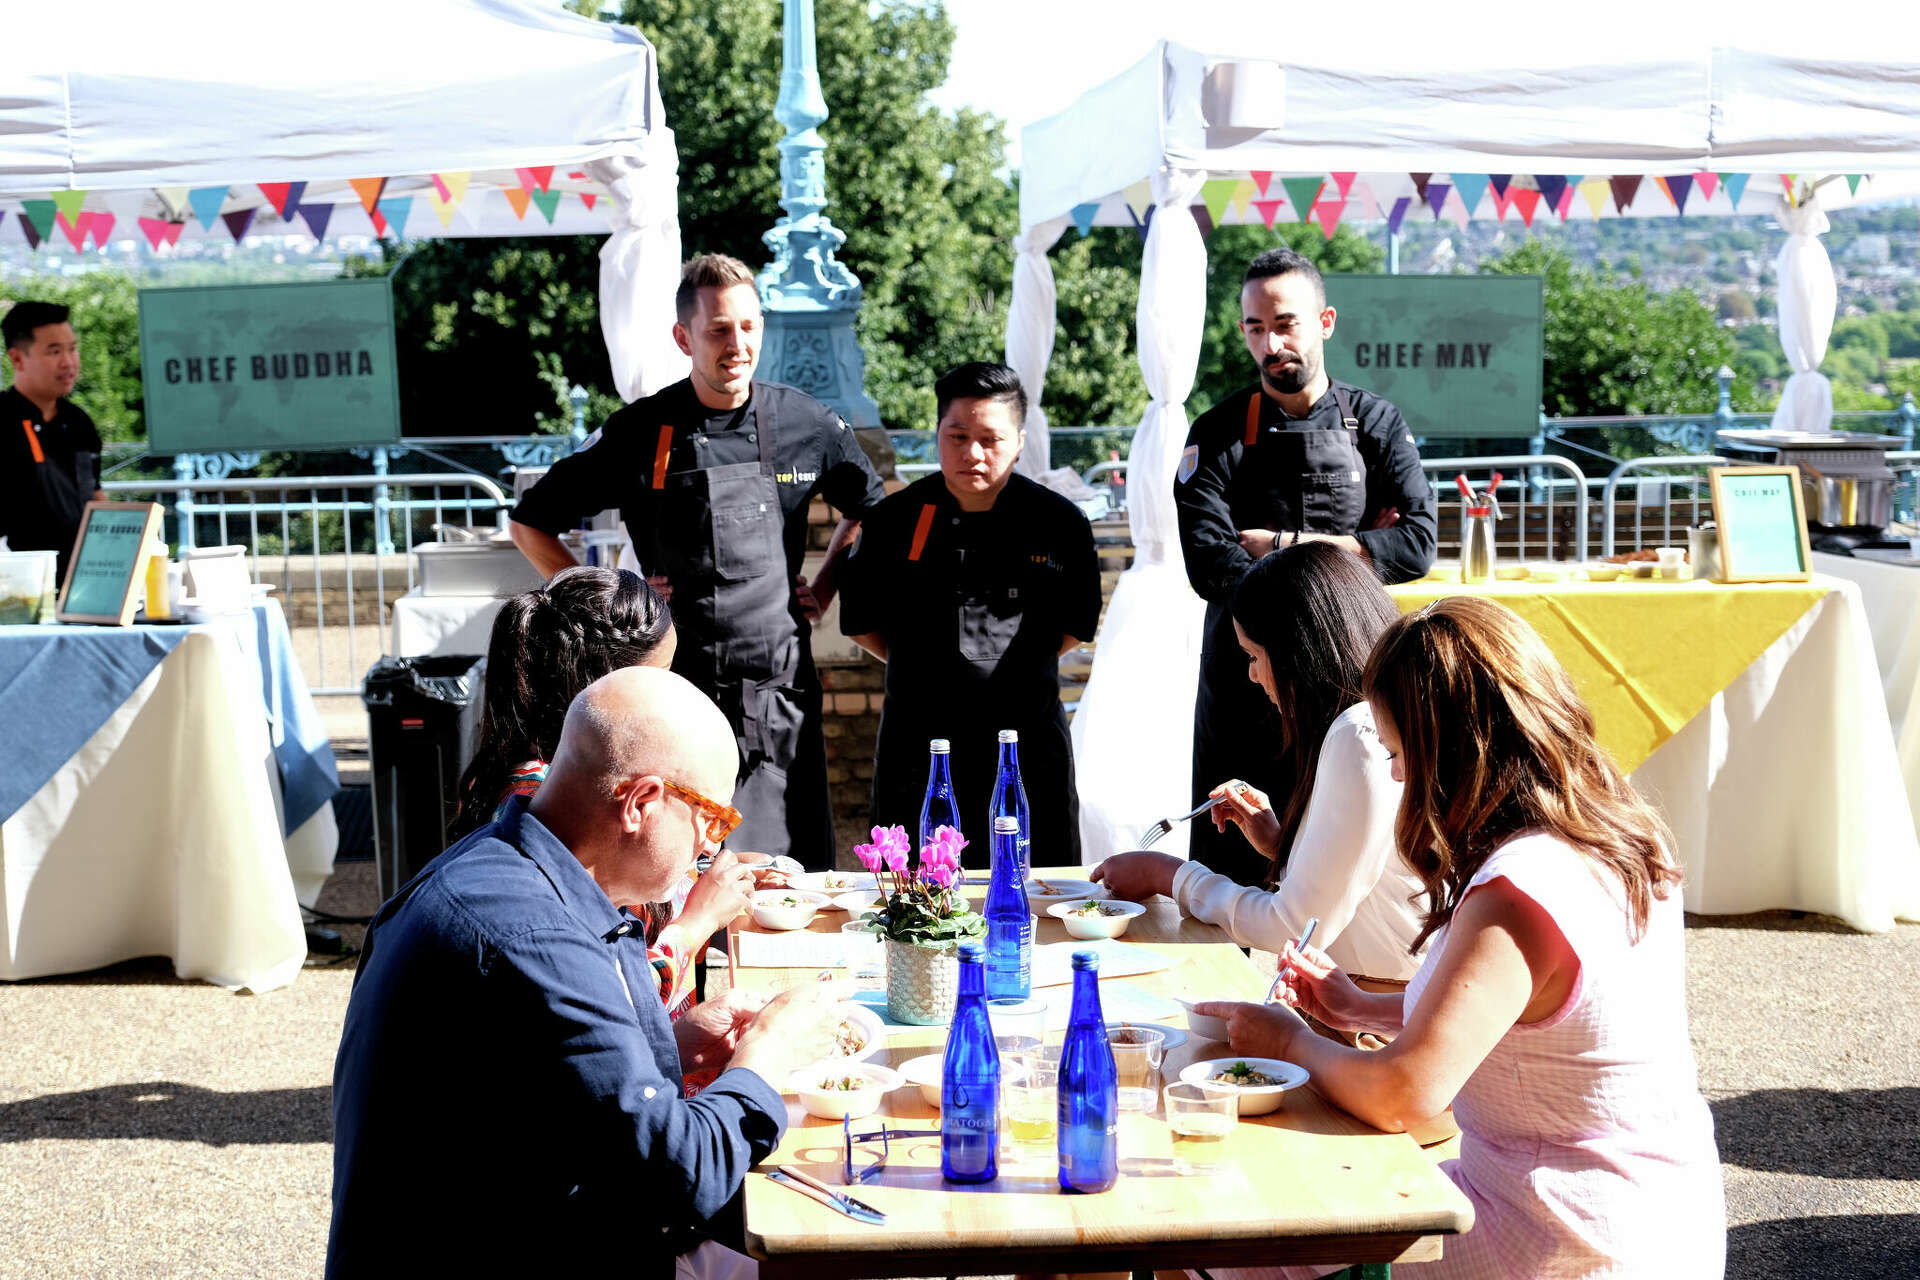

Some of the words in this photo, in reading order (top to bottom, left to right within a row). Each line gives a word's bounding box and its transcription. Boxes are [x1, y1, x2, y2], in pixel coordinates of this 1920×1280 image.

[165, 357, 237, 385] CHEF
[251, 350, 374, 380] BUDDHA
[1355, 342, 1423, 368] CHEF
[1436, 342, 1492, 368] MAY
[776, 473, 793, 483] TOP
